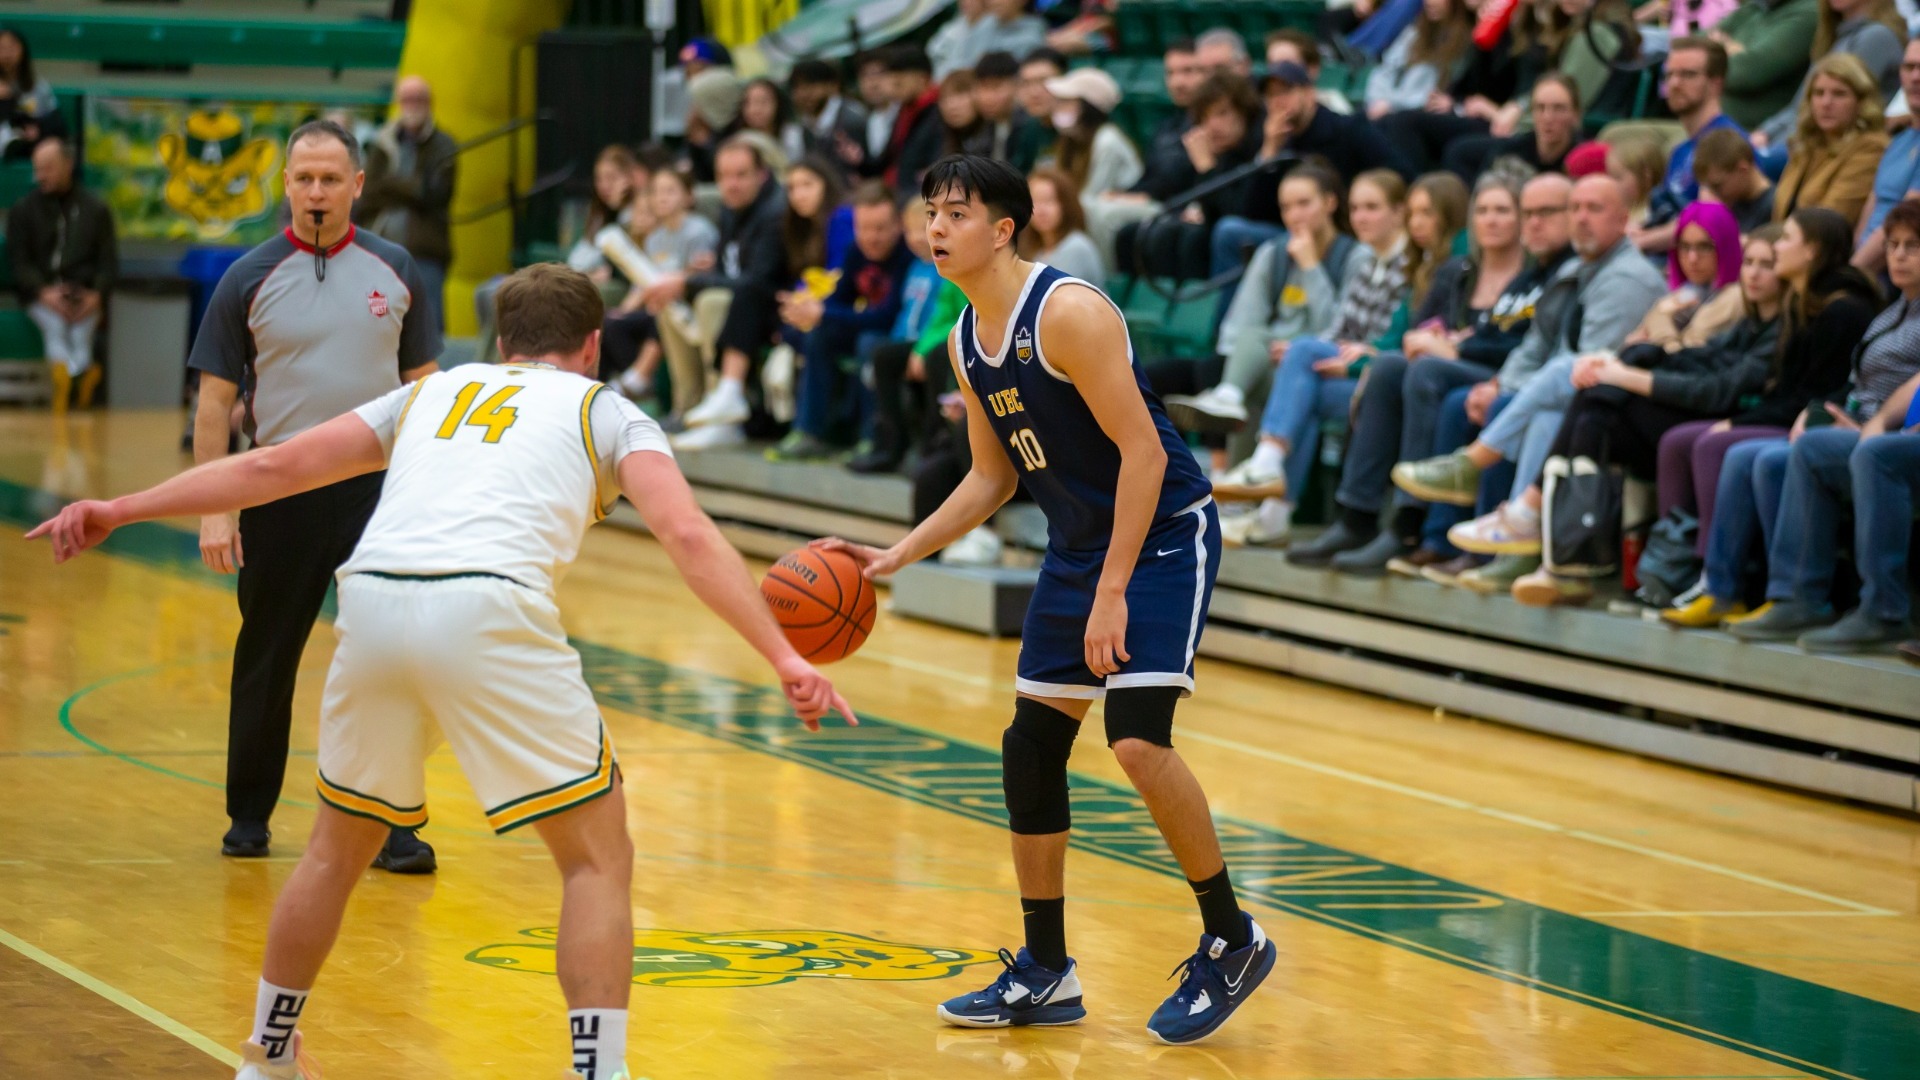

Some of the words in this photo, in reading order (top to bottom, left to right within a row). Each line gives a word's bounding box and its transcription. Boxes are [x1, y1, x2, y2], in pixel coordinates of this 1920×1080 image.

[434, 381, 526, 444] 14
[988, 387, 1025, 417] UBC
[1009, 428, 1047, 472] 10
